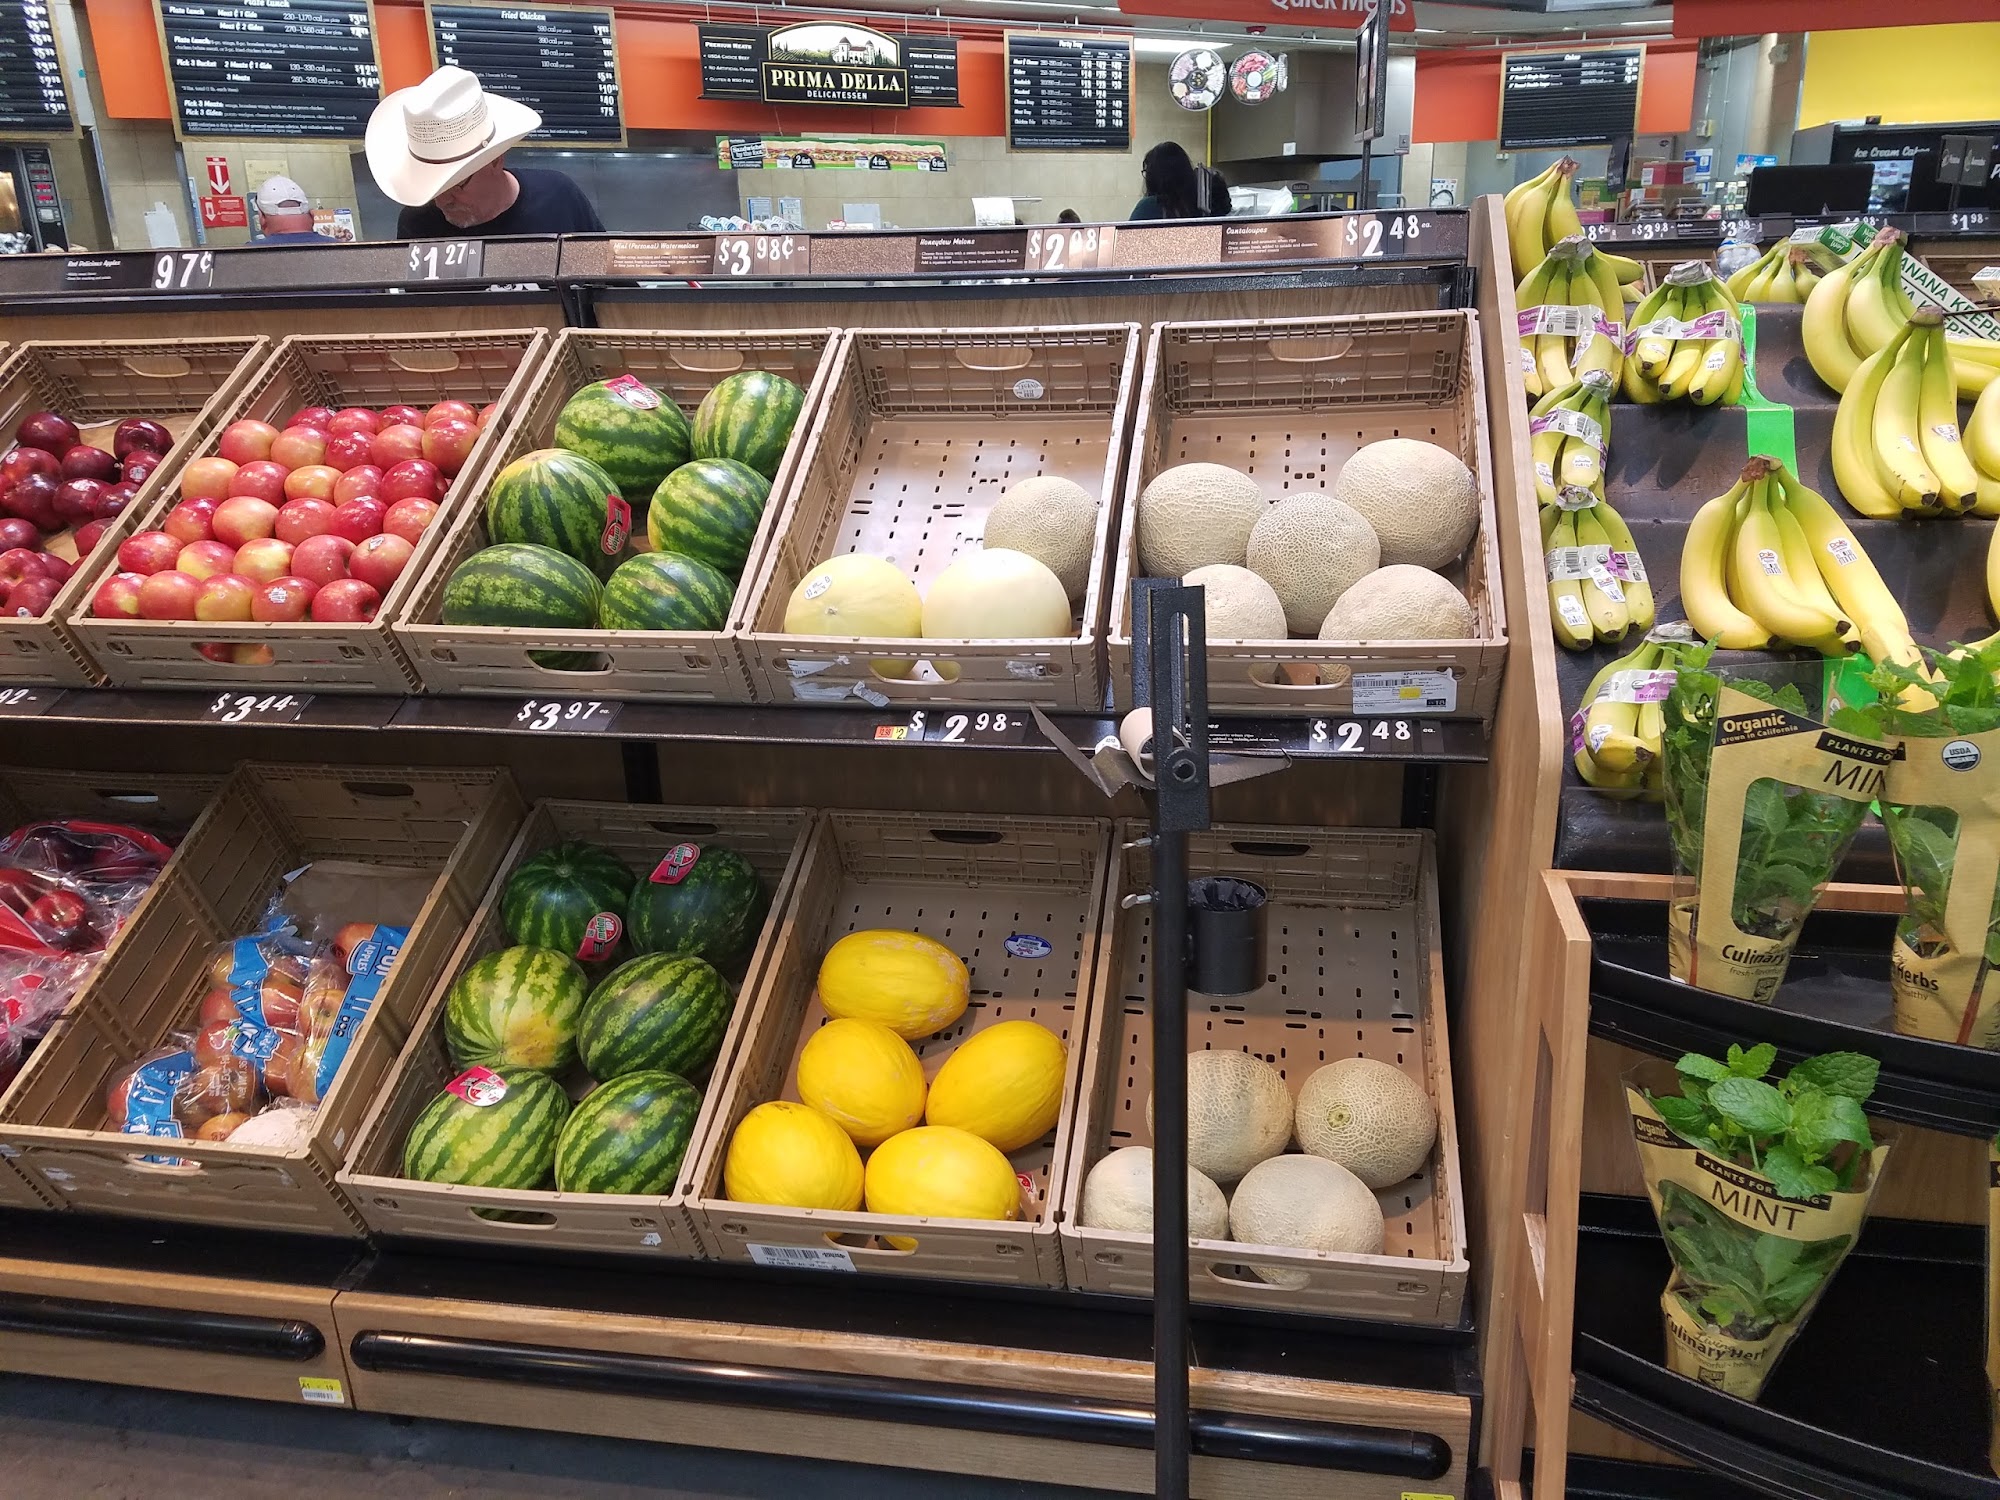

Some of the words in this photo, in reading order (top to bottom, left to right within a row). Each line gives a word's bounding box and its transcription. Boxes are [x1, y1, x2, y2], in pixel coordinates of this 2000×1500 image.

[501, 11, 518, 20] Fried
[519, 12, 546, 21] Chicken
[771, 69, 836, 90] PRIMA
[840, 72, 901, 92] DELLA
[807, 90, 868, 100] DELICATESSEN
[795, 155, 801, 164] 2
[1854, 148, 1868, 158] Ice
[1870, 147, 1899, 157] Cream
[1226, 227, 1267, 235] Cantaloupes
[920, 239, 951, 247] Honeydew
[1900, 256, 1950, 301] ANANA
[1722, 712, 1786, 733] Organic
[1720, 734, 1745, 745] grown
[1747, 731, 1756, 740] in
[1757, 724, 1799, 738] California
[1827, 738, 1873, 758] PLANTS
[1875, 750, 1895, 761] FO
[1949, 747, 1971, 756] USDA
[1823, 760, 1887, 794] MIN
[357, 944, 377, 972] APPLES
[1722, 944, 1787, 966] Culinary
[1636, 1118, 1669, 1139] Organic
[1703, 1159, 1745, 1184] PLANTS
[1748, 1180, 1773, 1194] FOR
[1711, 1180, 1806, 1231] MINT
